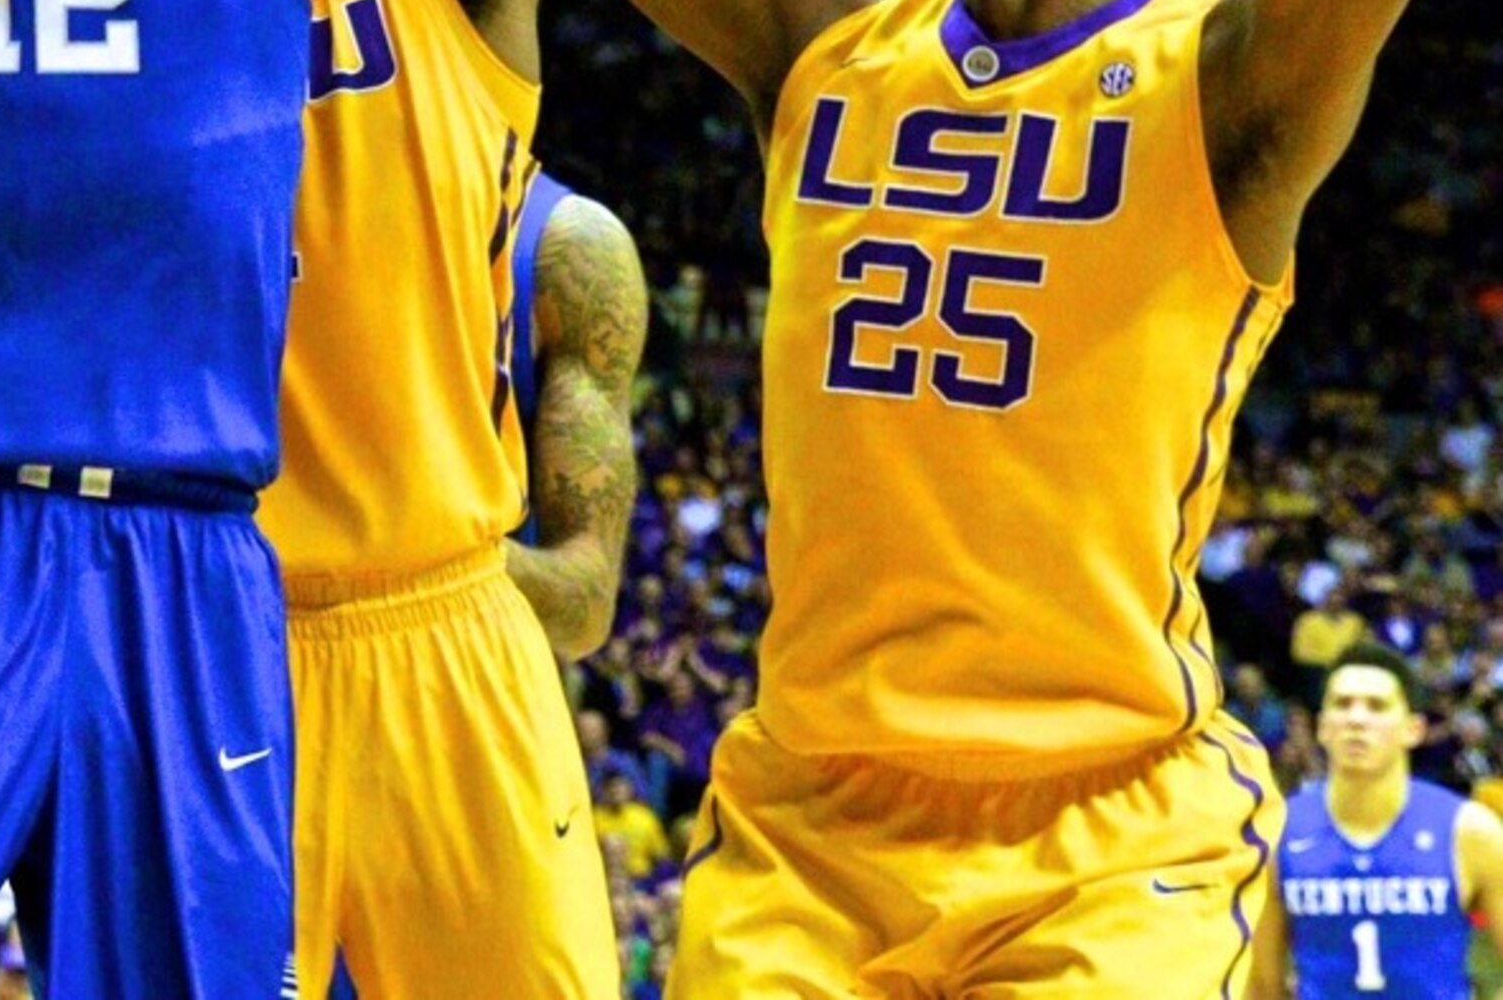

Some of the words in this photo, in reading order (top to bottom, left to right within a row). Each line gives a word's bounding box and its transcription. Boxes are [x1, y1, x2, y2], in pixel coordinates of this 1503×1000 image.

[796, 94, 1133, 224] LSU
[822, 237, 1047, 413] 25
[1284, 877, 1450, 916] KENTUCKY
[1352, 920, 1386, 992] 1
